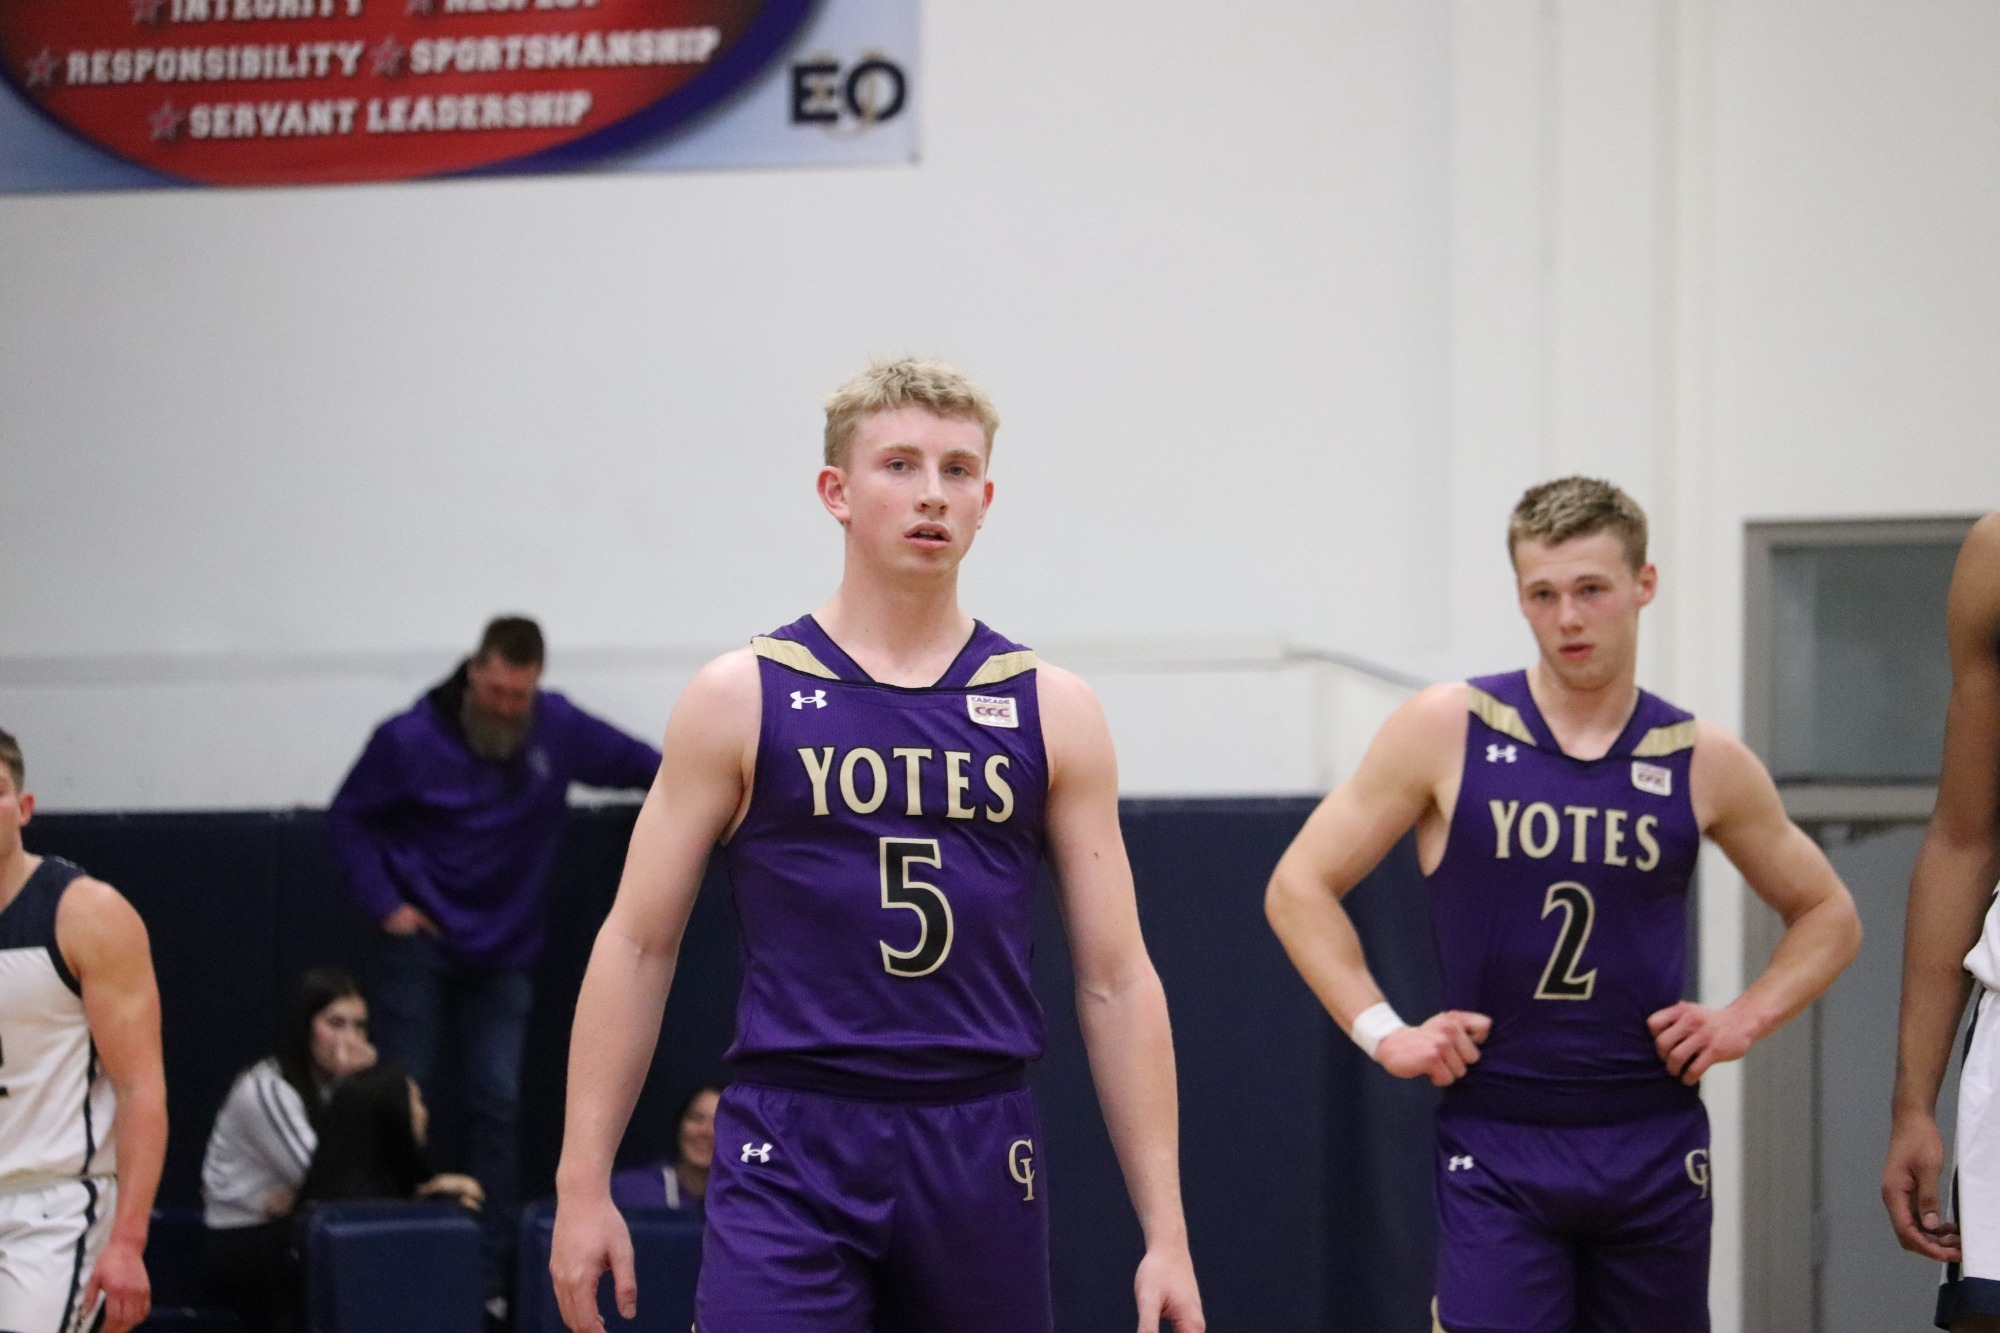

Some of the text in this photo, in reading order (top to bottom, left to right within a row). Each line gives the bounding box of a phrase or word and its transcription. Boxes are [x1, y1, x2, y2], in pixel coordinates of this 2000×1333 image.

[67, 28, 721, 85] RESPONSIBILITY SPORTSMANSHIP
[188, 91, 593, 138] SERVANT LEADERSHIP
[970, 697, 1011, 705] CASCADE
[974, 706, 1011, 718] CCC
[797, 746, 1015, 823] YOTES
[1489, 799, 1661, 872] YOTES
[879, 836, 954, 977] 5
[1533, 881, 1598, 1000] 2
